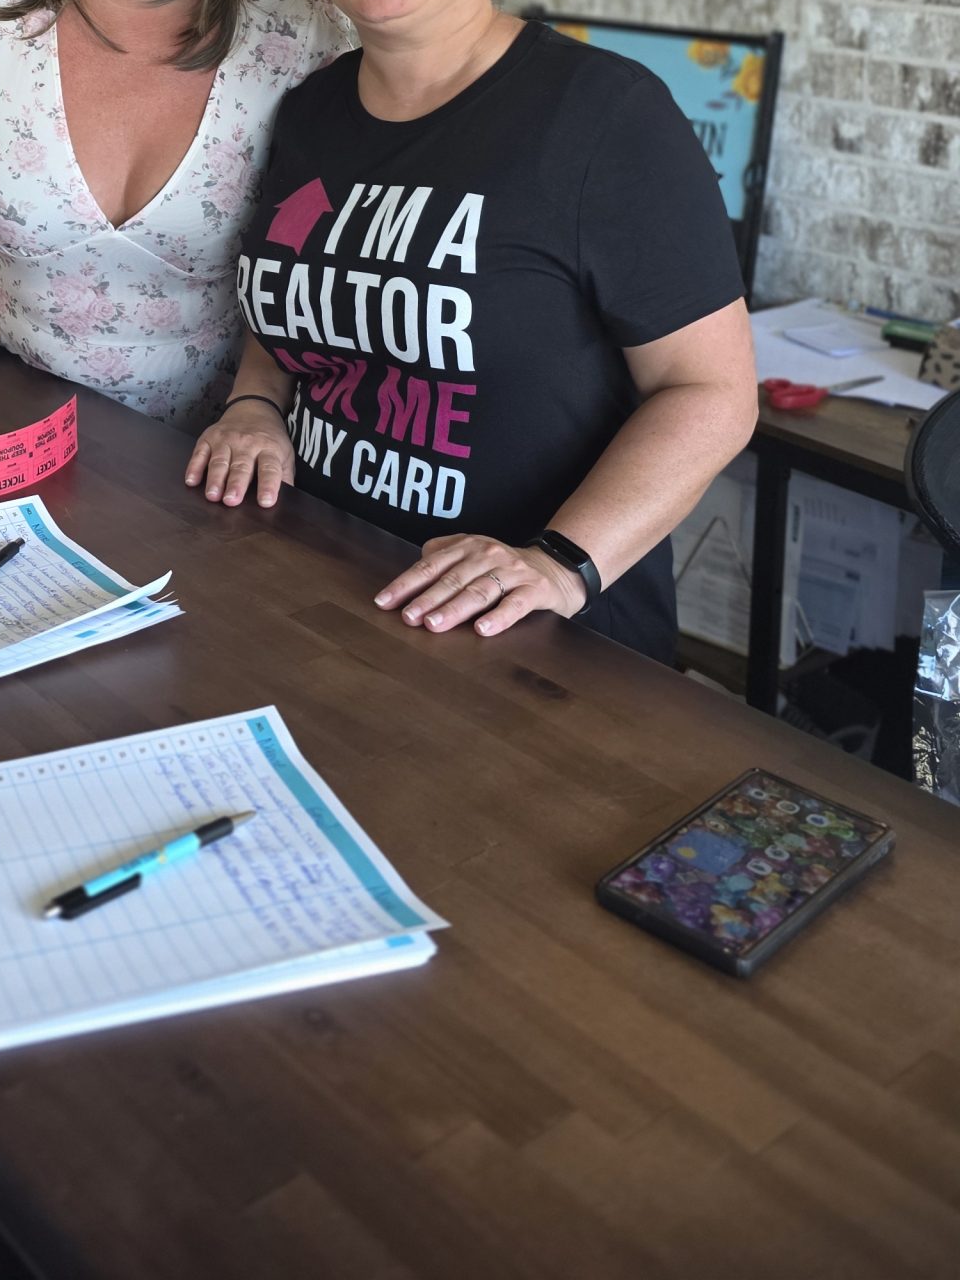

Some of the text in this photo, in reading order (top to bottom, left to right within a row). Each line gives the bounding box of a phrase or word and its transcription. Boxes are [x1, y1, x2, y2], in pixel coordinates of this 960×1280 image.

[427, 192, 485, 274] A
[237, 254, 476, 372] REALTOR
[37, 427, 56, 441] COUPON
[375, 365, 477, 459] ME
[11, 448, 27, 459] KEEP
[35, 433, 57, 449] KEEP THIS
[298, 406, 348, 478] MY
[349, 439, 466, 519] CARD
[36, 457, 57, 476] TICKET
